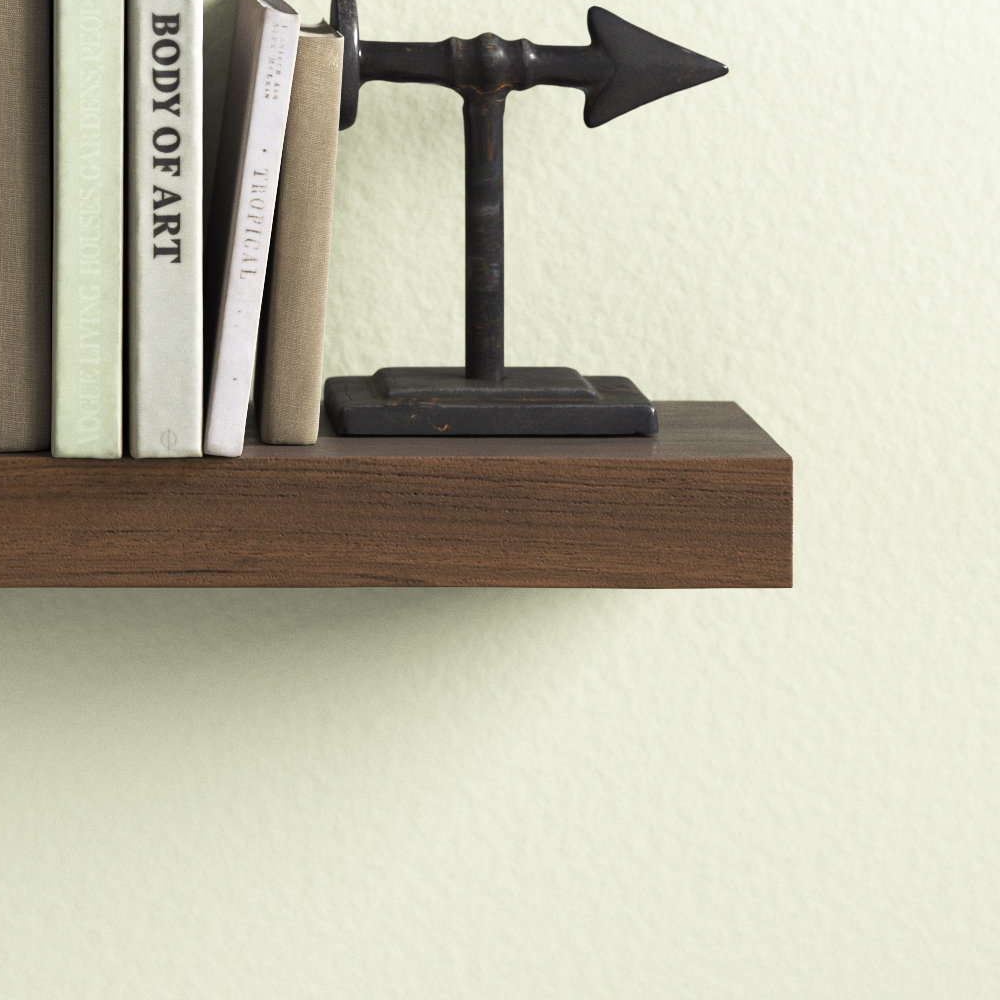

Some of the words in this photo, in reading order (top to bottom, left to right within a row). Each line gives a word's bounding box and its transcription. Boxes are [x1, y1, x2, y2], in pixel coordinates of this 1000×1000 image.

[152, 12, 180, 118] BODY
[152, 126, 181, 177] OF
[153, 184, 182, 264] ART
[240, 168, 269, 280] TROPICAL
